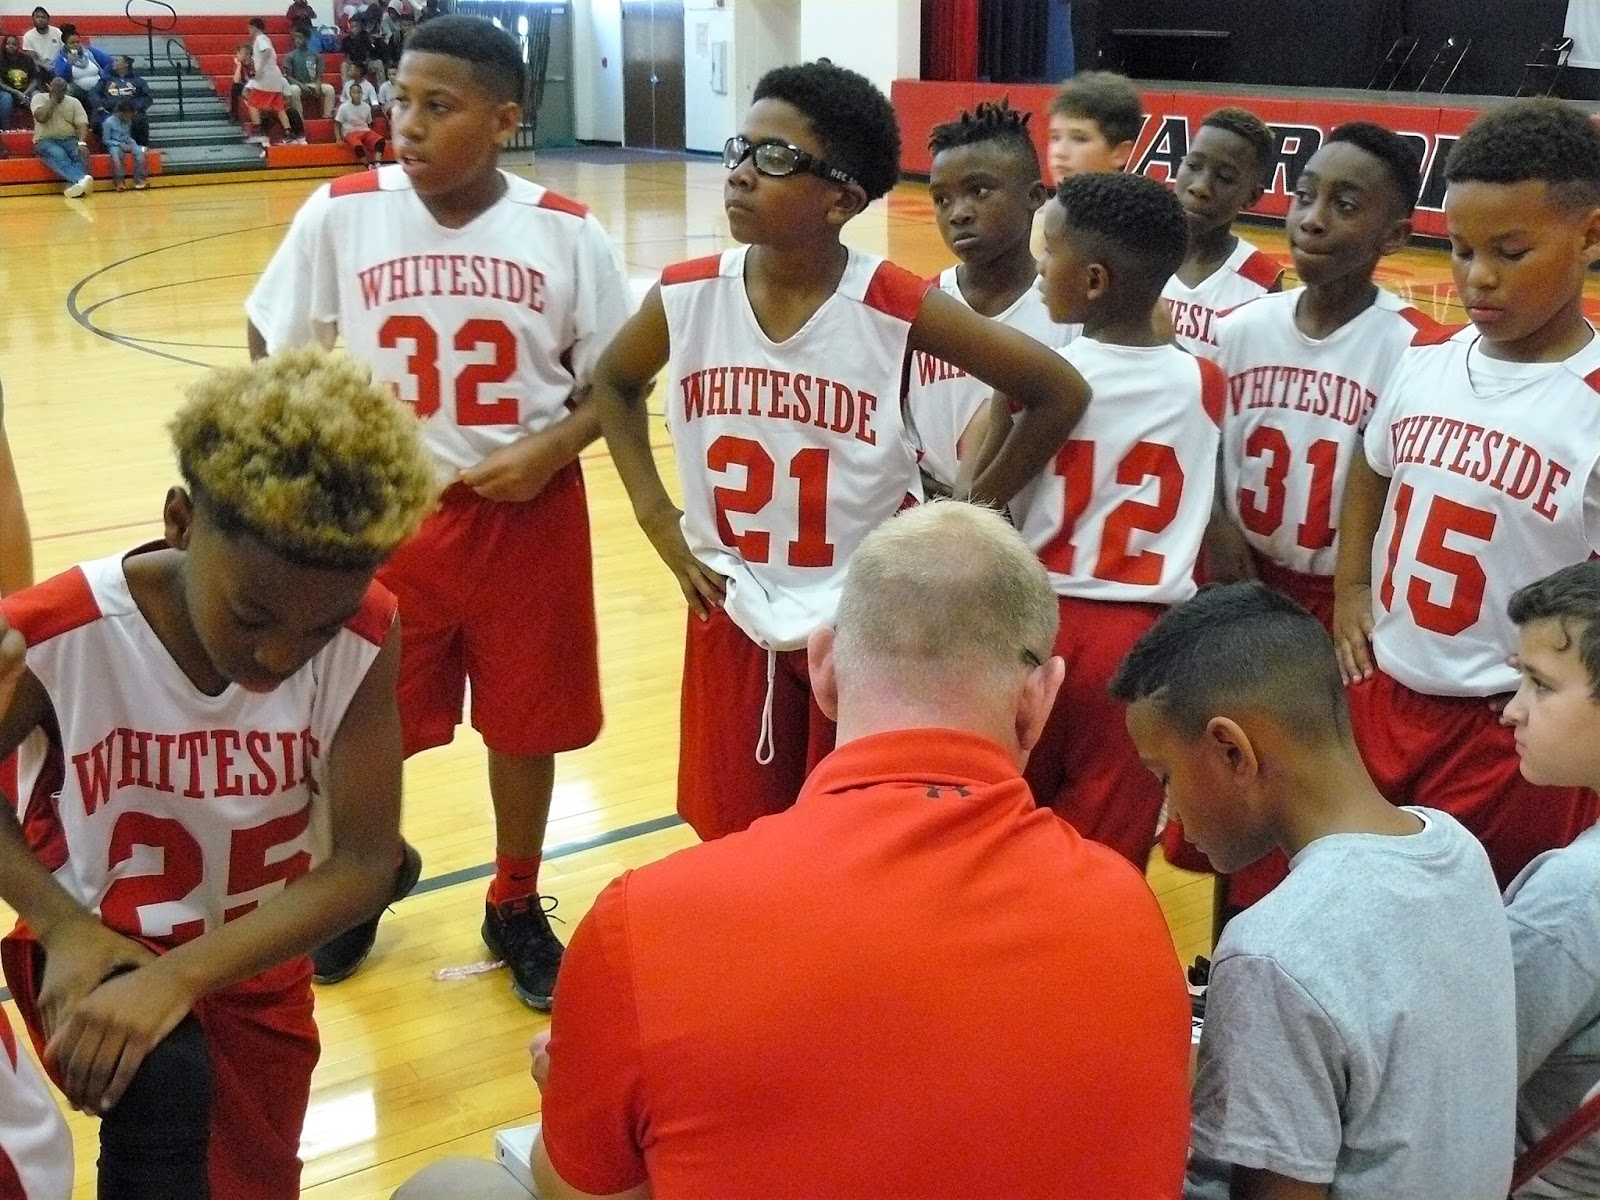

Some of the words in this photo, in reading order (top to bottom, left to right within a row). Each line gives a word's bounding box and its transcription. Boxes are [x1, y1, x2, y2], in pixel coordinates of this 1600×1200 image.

[357, 254, 545, 314] WHITESIDE
[378, 315, 518, 425] 32
[681, 367, 877, 446] WHITESIDE
[707, 435, 834, 567] 21
[1034, 439, 1184, 585] 12
[1238, 426, 1339, 550] 31
[1380, 482, 1497, 636] 15
[100, 809, 313, 950] 25
